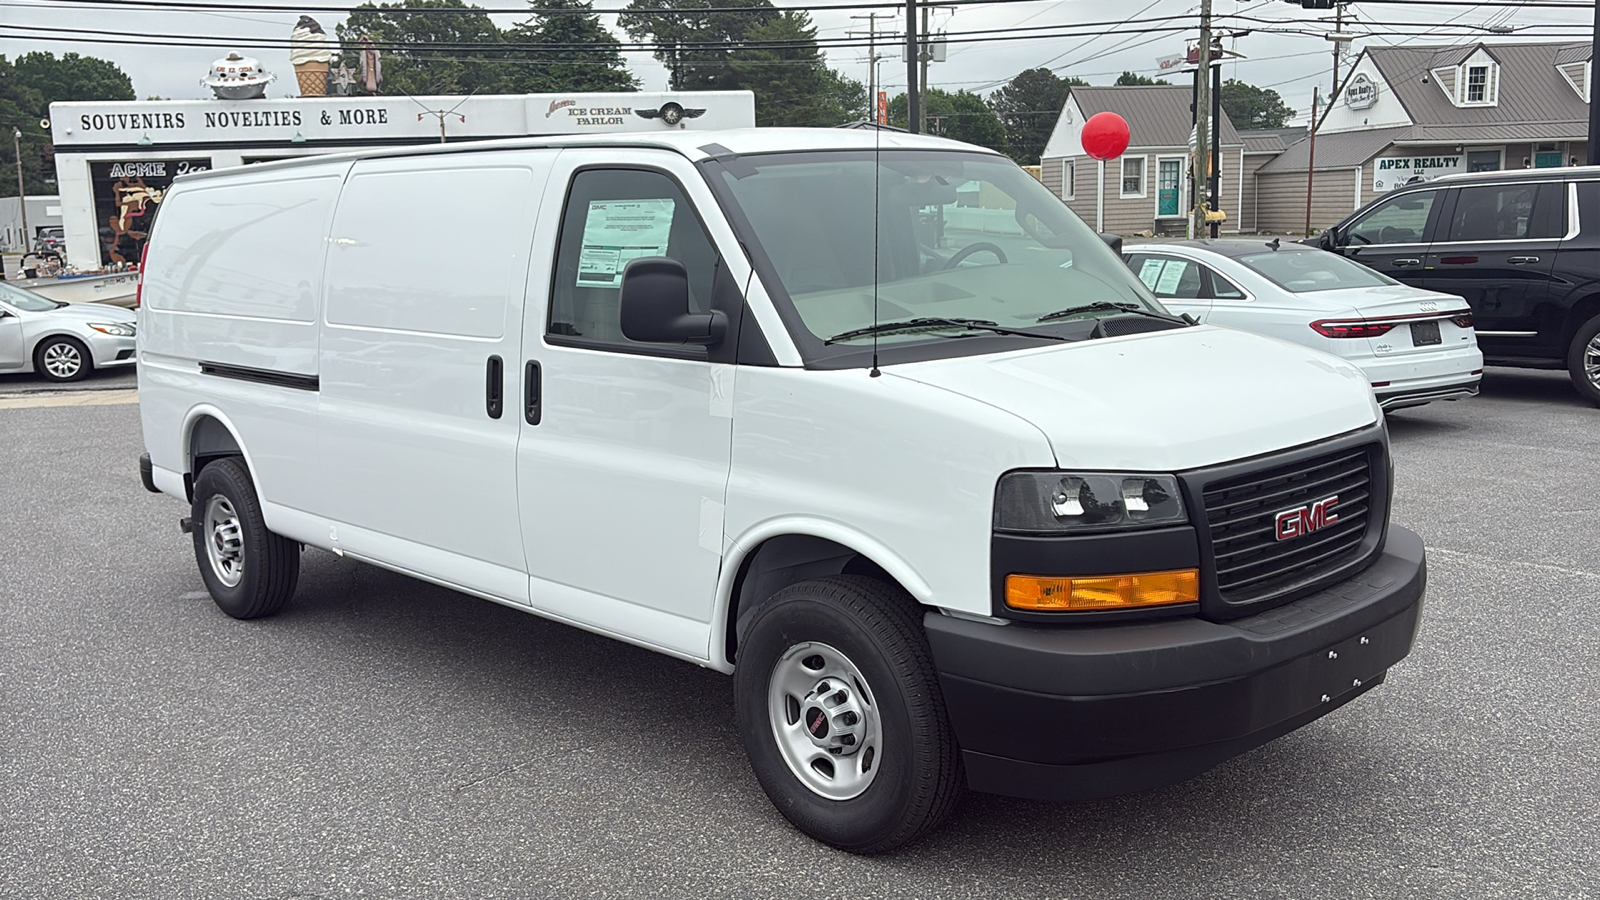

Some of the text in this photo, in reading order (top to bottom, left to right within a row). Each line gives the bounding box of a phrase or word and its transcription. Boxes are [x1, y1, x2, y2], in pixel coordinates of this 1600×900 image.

[568, 107, 632, 116] ICE CREAM
[80, 108, 388, 131] SOUVENIRS NOVELTIES & MORE
[576, 117, 624, 125] PARLOR
[110, 162, 167, 178] ACME
[1379, 157, 1459, 170] APEX REALTY
[1275, 495, 1339, 541] GMC
